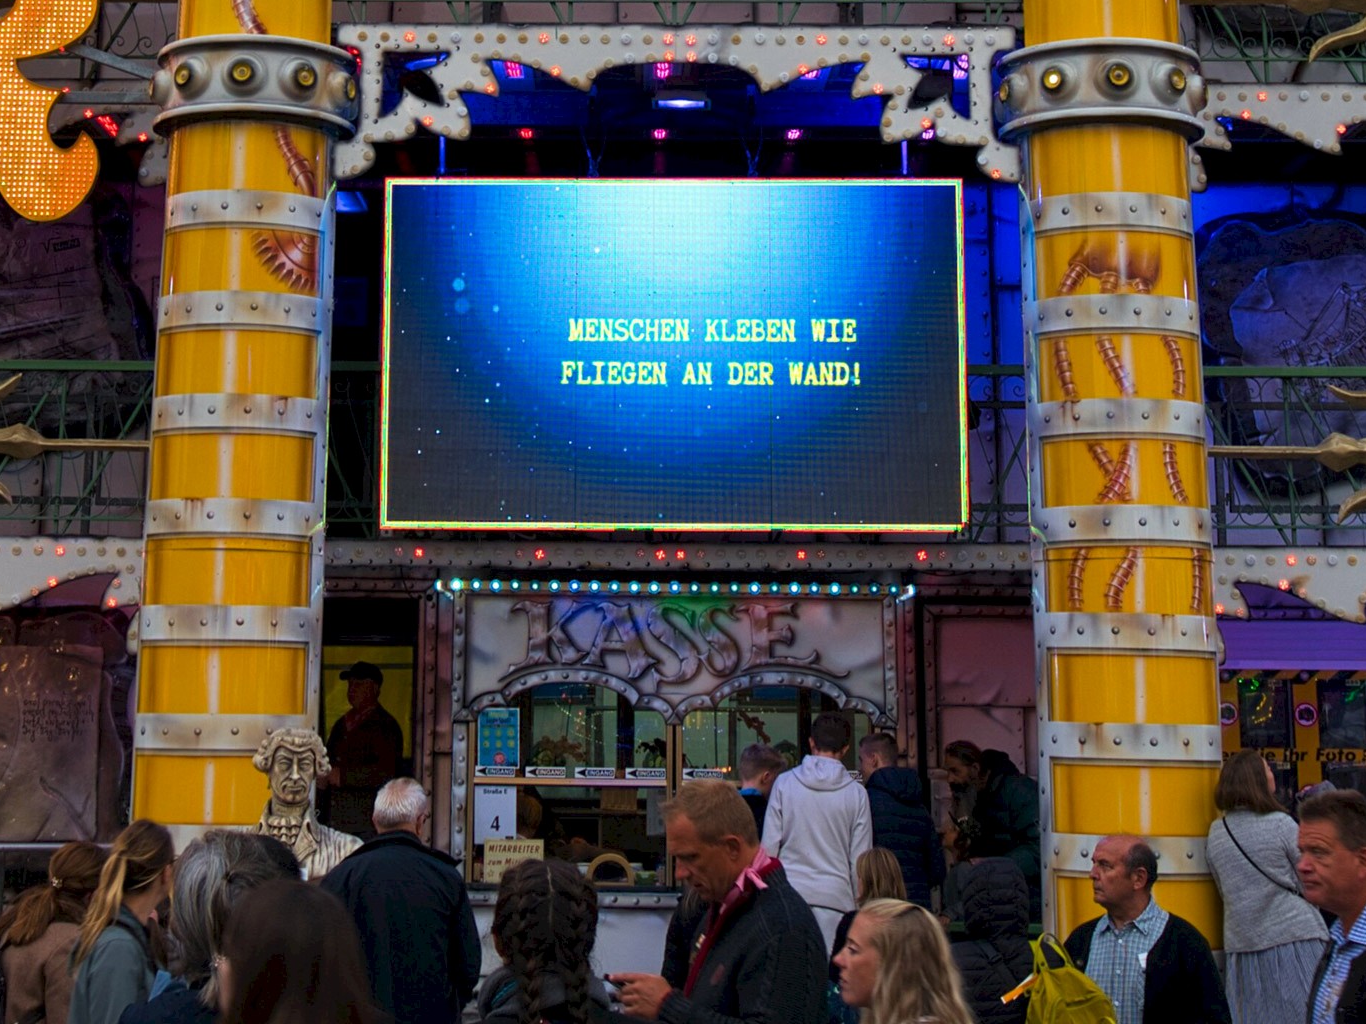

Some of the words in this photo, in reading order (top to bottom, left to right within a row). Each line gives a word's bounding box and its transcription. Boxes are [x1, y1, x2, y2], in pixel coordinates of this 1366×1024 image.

[568, 318, 689, 342] MENSCHEN
[704, 318, 796, 342] KLEBEN
[811, 318, 857, 342] WIE
[560, 361, 667, 385] FLIEGEN
[682, 362, 713, 385] AN
[727, 362, 774, 385] DER
[788, 362, 861, 386] WAND!
[501, 600, 849, 685] KASSE
[1316, 748, 1356, 762] Foto
[490, 815, 501, 831] 4
[488, 844, 540, 854] MITARBEITER
